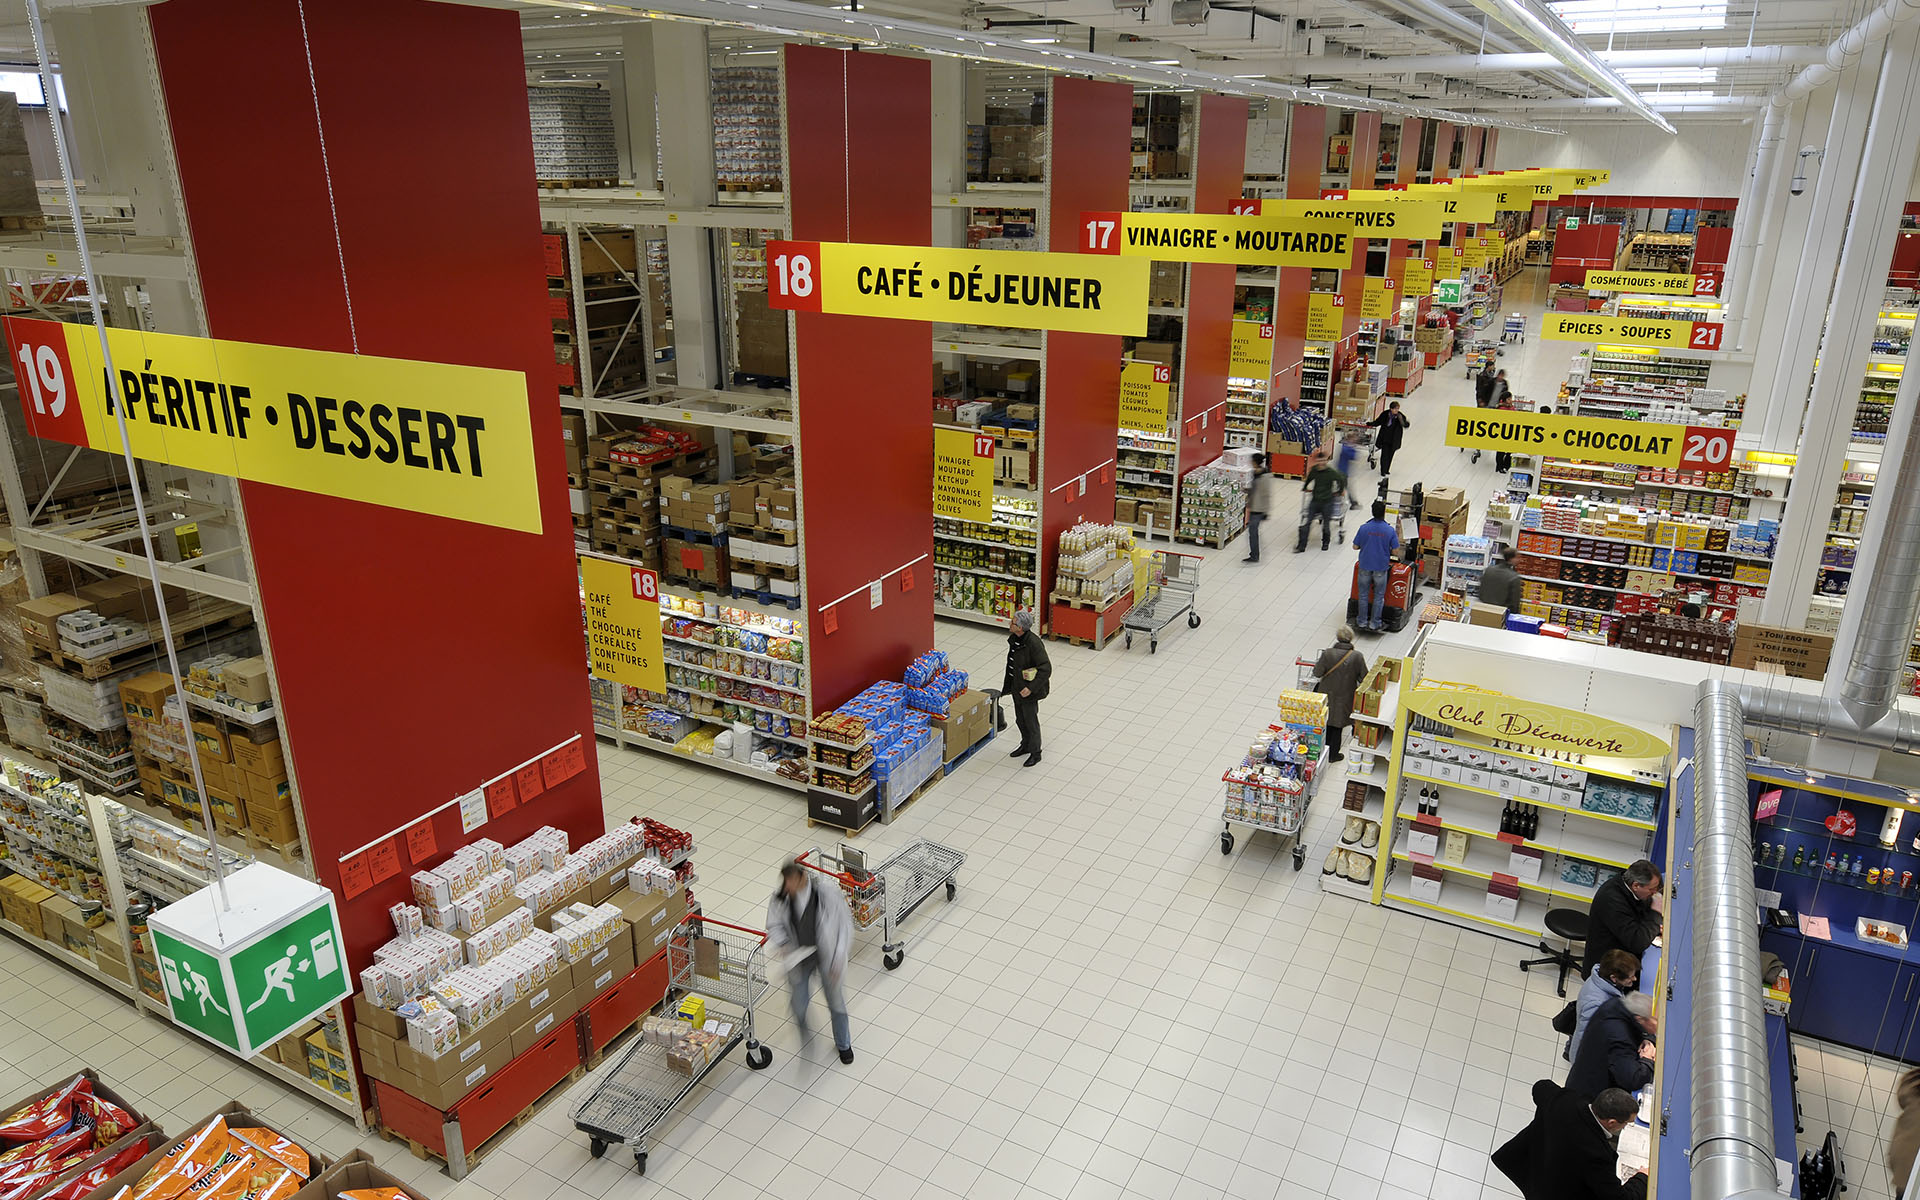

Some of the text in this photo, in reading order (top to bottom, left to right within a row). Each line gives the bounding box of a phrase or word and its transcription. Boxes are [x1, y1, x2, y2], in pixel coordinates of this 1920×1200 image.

[1086, 221, 1347, 254] 17 VINAIGRE MOUTARDE
[774, 255, 1102, 310] 18 CAFÉ DÉJEUNER
[1385, 280, 1394, 288] 13
[1590, 274, 1714, 292] COSMÉTIQUES BÉBÉ 22
[1334, 296, 1344, 306] 14
[1260, 326, 1272, 338] 15
[1558, 319, 1717, 345] ÉPICES SOUPES 21
[1155, 368, 1168, 382] 16
[1124, 382, 1152, 390] POISSONS
[1123, 390, 1148, 398] TOMATES
[18, 342, 485, 478] 19 APÉRITIF DESSERT
[976, 438, 992, 455] 17
[1456, 418, 1728, 464] BISCUITS CHOCOLAT 20
[938, 456, 970, 466] VINAIGRE
[938, 466, 974, 477] MOUTARDE
[938, 475, 968, 486] KETCHUP
[938, 485, 981, 498] MAYONNAISE
[938, 494, 981, 508] CORNICHONS
[938, 504, 961, 514] OLIVES
[633, 572, 656, 598] 18
[589, 592, 612, 606] CAFÉ
[590, 606, 607, 618] THÉ
[594, 632, 637, 652] CÉRÉALES
[594, 647, 648, 668] CONFITURES
[596, 660, 616, 674] MIEL
[1438, 704, 1622, 753] Club Découverte
[1758, 798, 1780, 812] love
